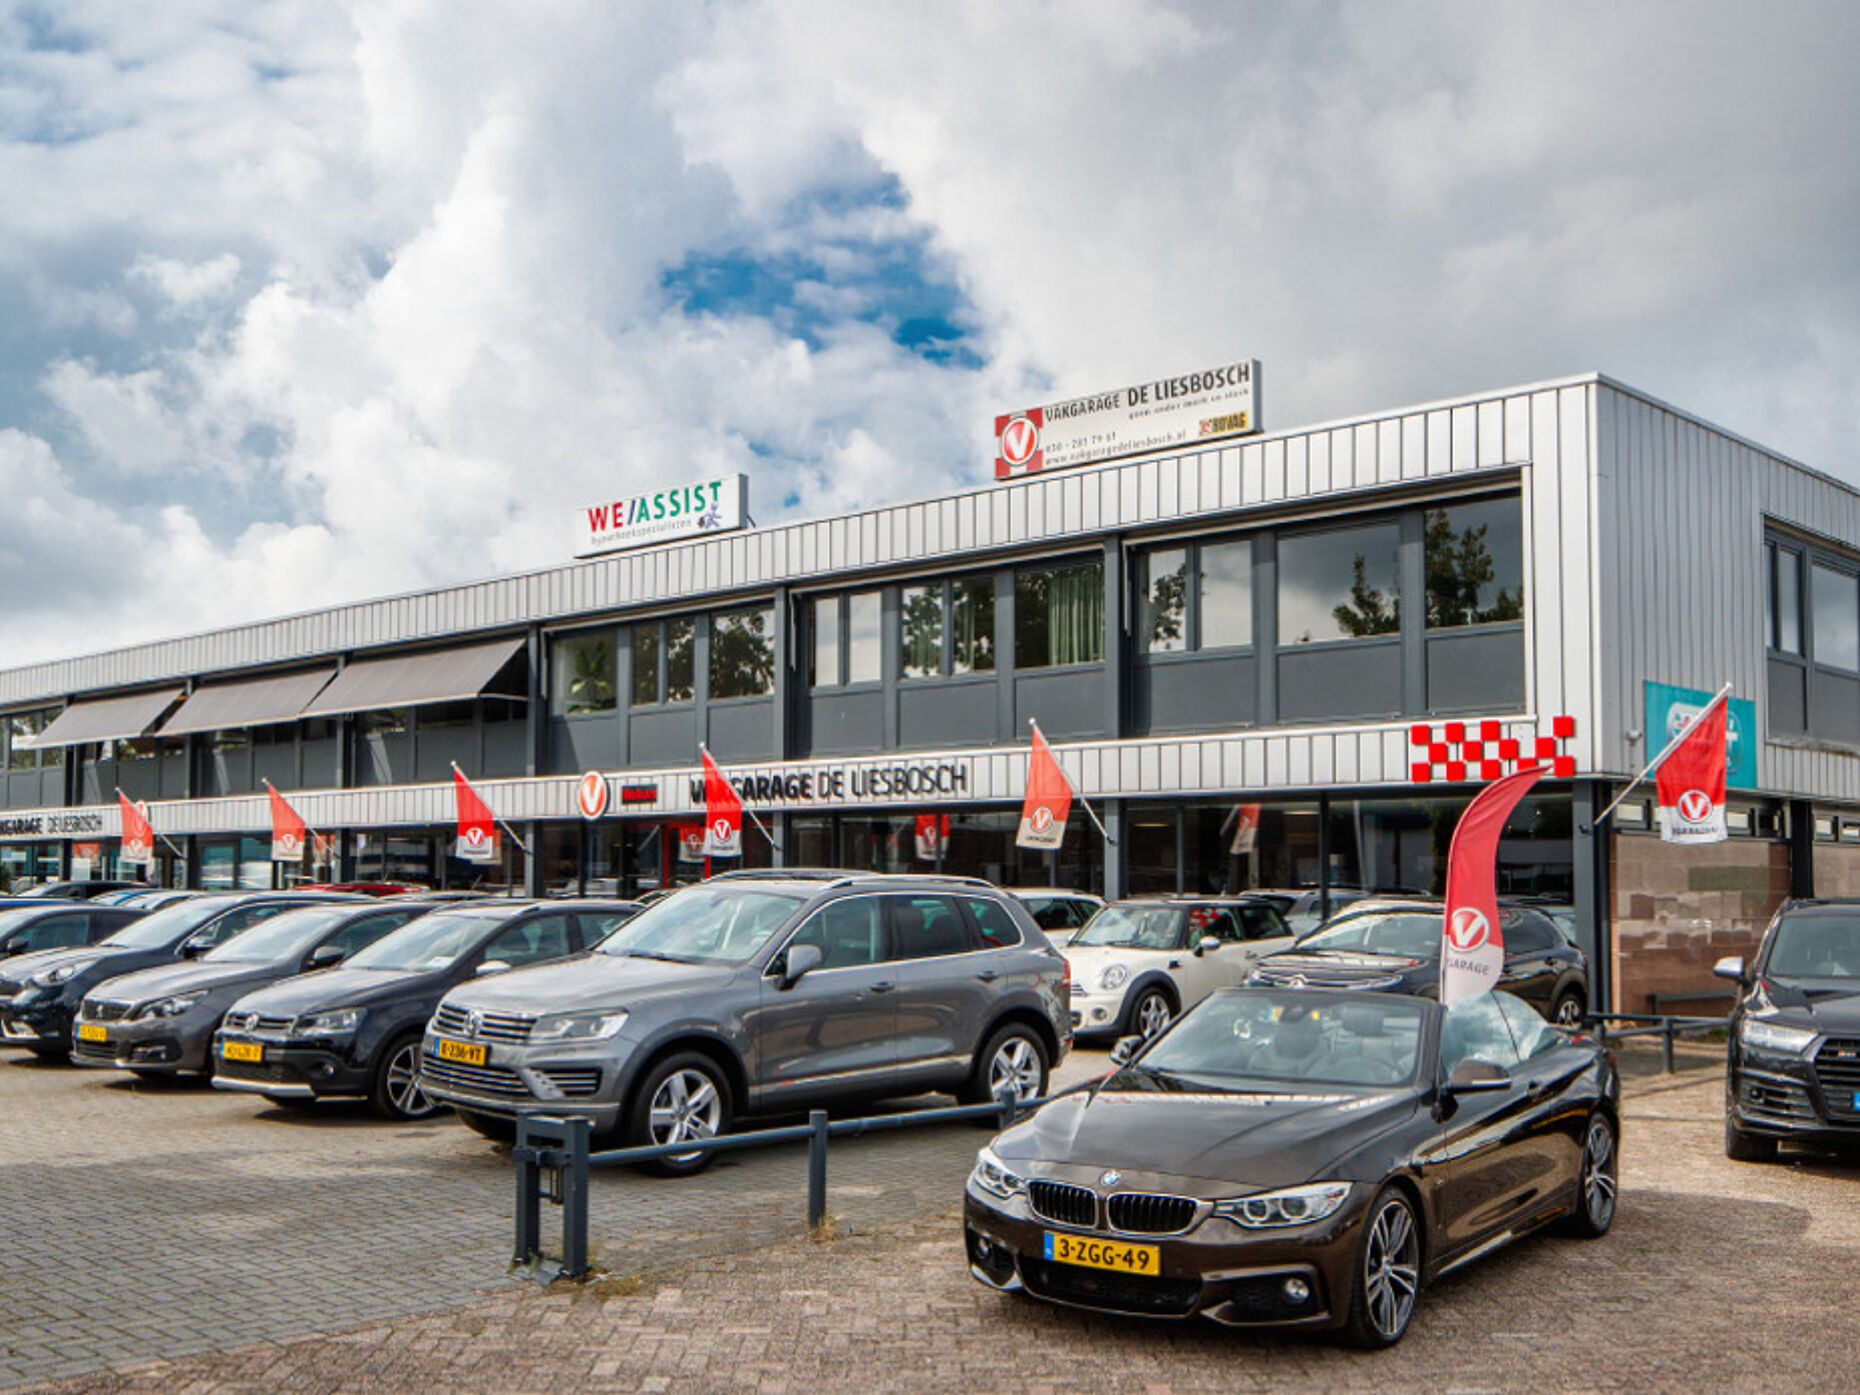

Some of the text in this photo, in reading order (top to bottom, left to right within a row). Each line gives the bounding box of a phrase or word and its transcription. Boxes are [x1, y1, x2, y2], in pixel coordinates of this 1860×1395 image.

[1045, 363, 1250, 422] VAKGARAGE DE LIESBOSCH
[818, 770, 843, 797] DE
[851, 764, 968, 796] LIESBOSCH
[1060, 1239, 1150, 1269] 3-ZGG-49
